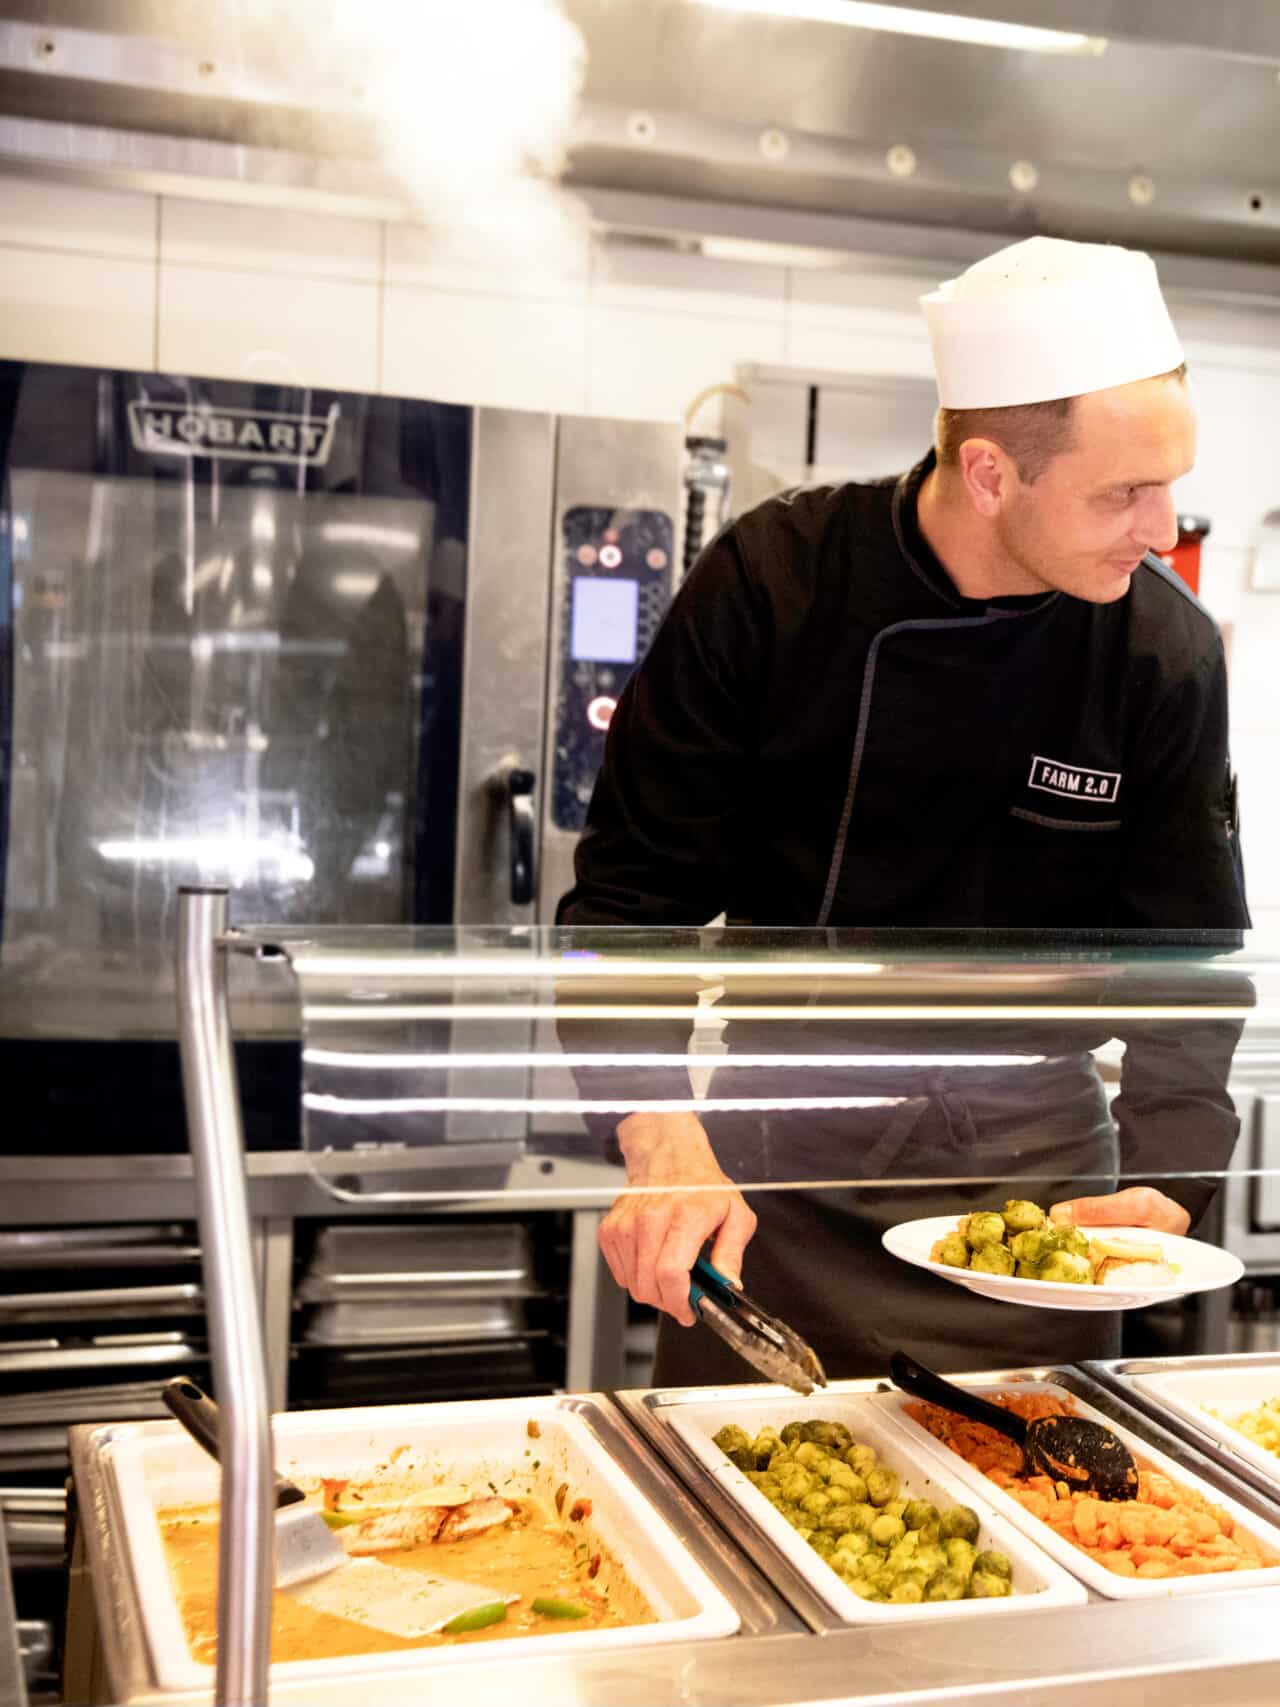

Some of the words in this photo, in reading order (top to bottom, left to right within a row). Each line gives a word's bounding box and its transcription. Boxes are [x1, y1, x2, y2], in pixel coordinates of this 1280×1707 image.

[145, 411, 323, 450] HOBART
[1041, 766, 1081, 792] FARM
[1084, 776, 1109, 795] 2.0
